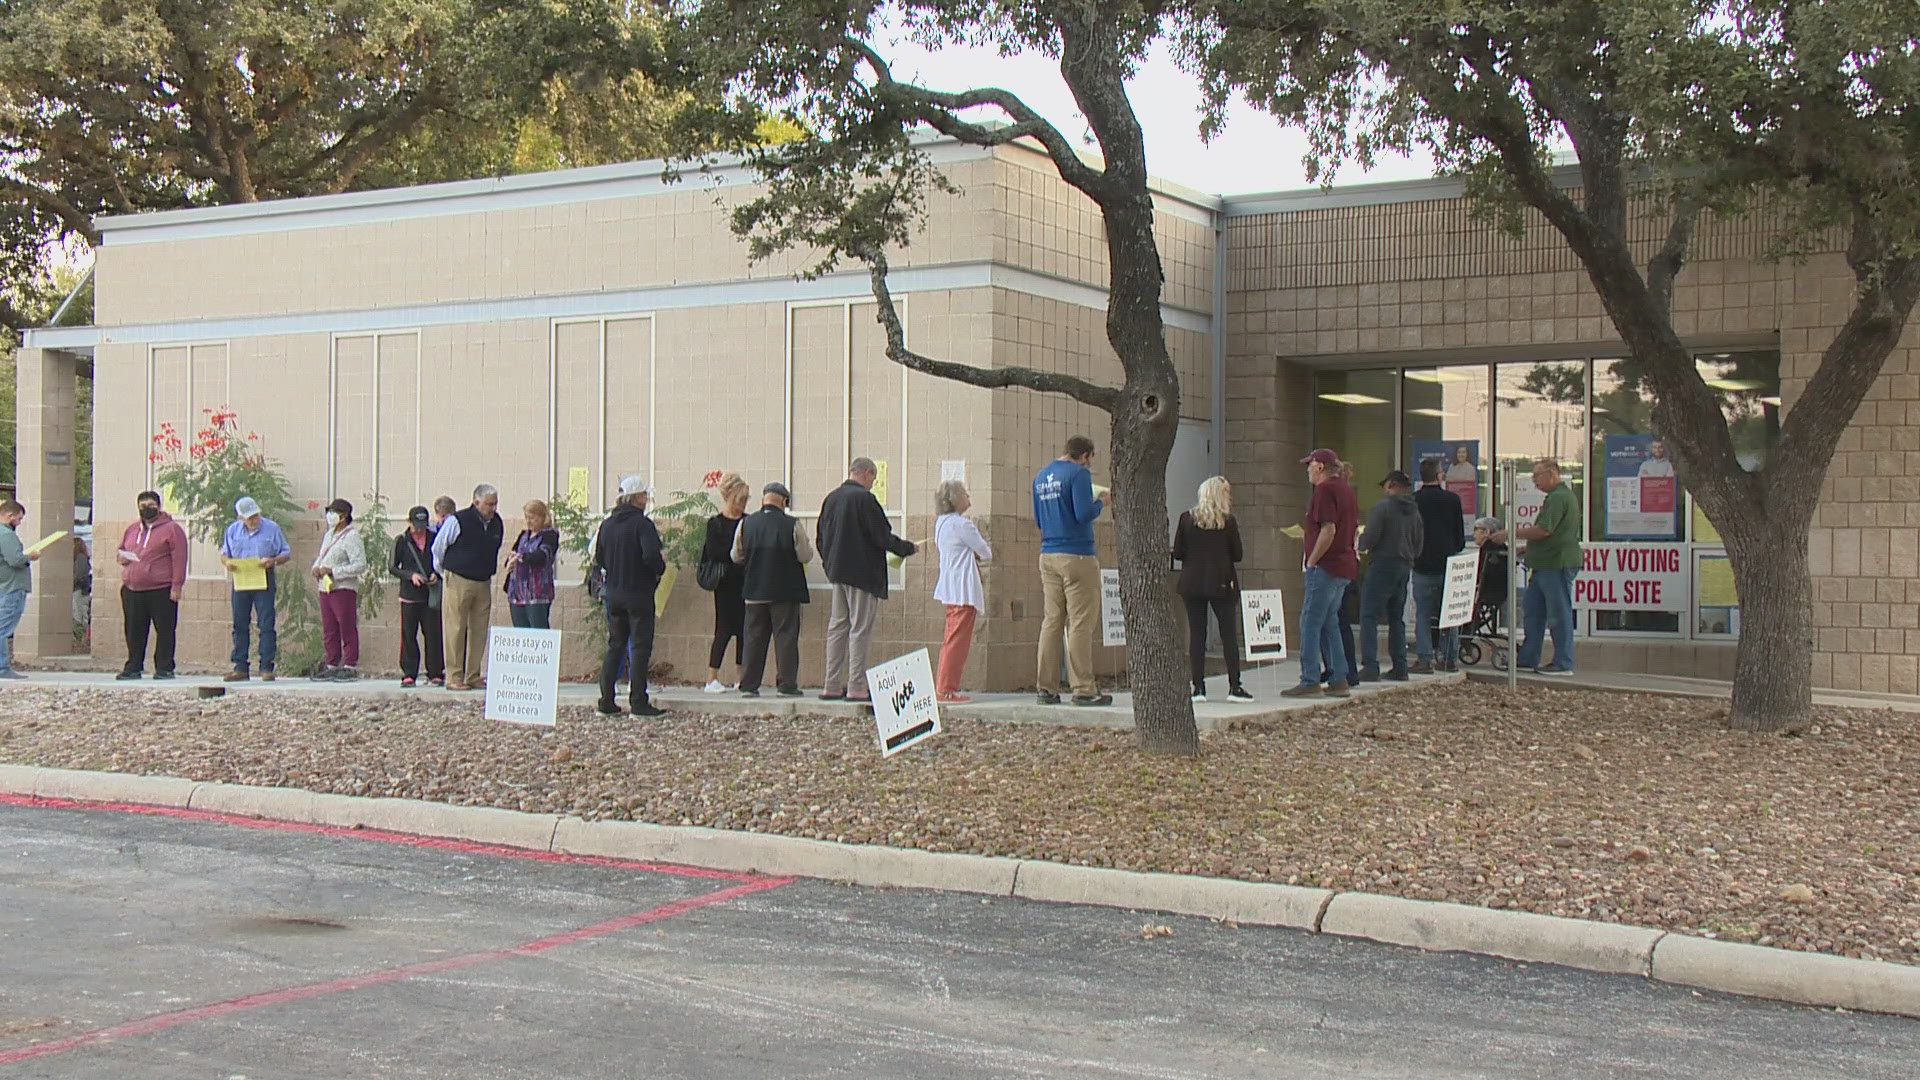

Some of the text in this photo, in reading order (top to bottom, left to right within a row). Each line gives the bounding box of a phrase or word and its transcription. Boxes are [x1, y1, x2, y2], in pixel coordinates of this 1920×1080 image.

[1583, 549, 1679, 572] RLY VOTING
[1575, 580, 1661, 604] POLL SITE
[1256, 608, 1271, 632] Vote
[494, 635, 553, 651] Please stay on
[496, 651, 549, 665] the sidewalk
[502, 674, 538, 688] Por favor,
[496, 689, 542, 701] permanezca
[891, 680, 915, 717] Vote
[498, 703, 539, 716] en la acera
[913, 696, 932, 713] HERE
